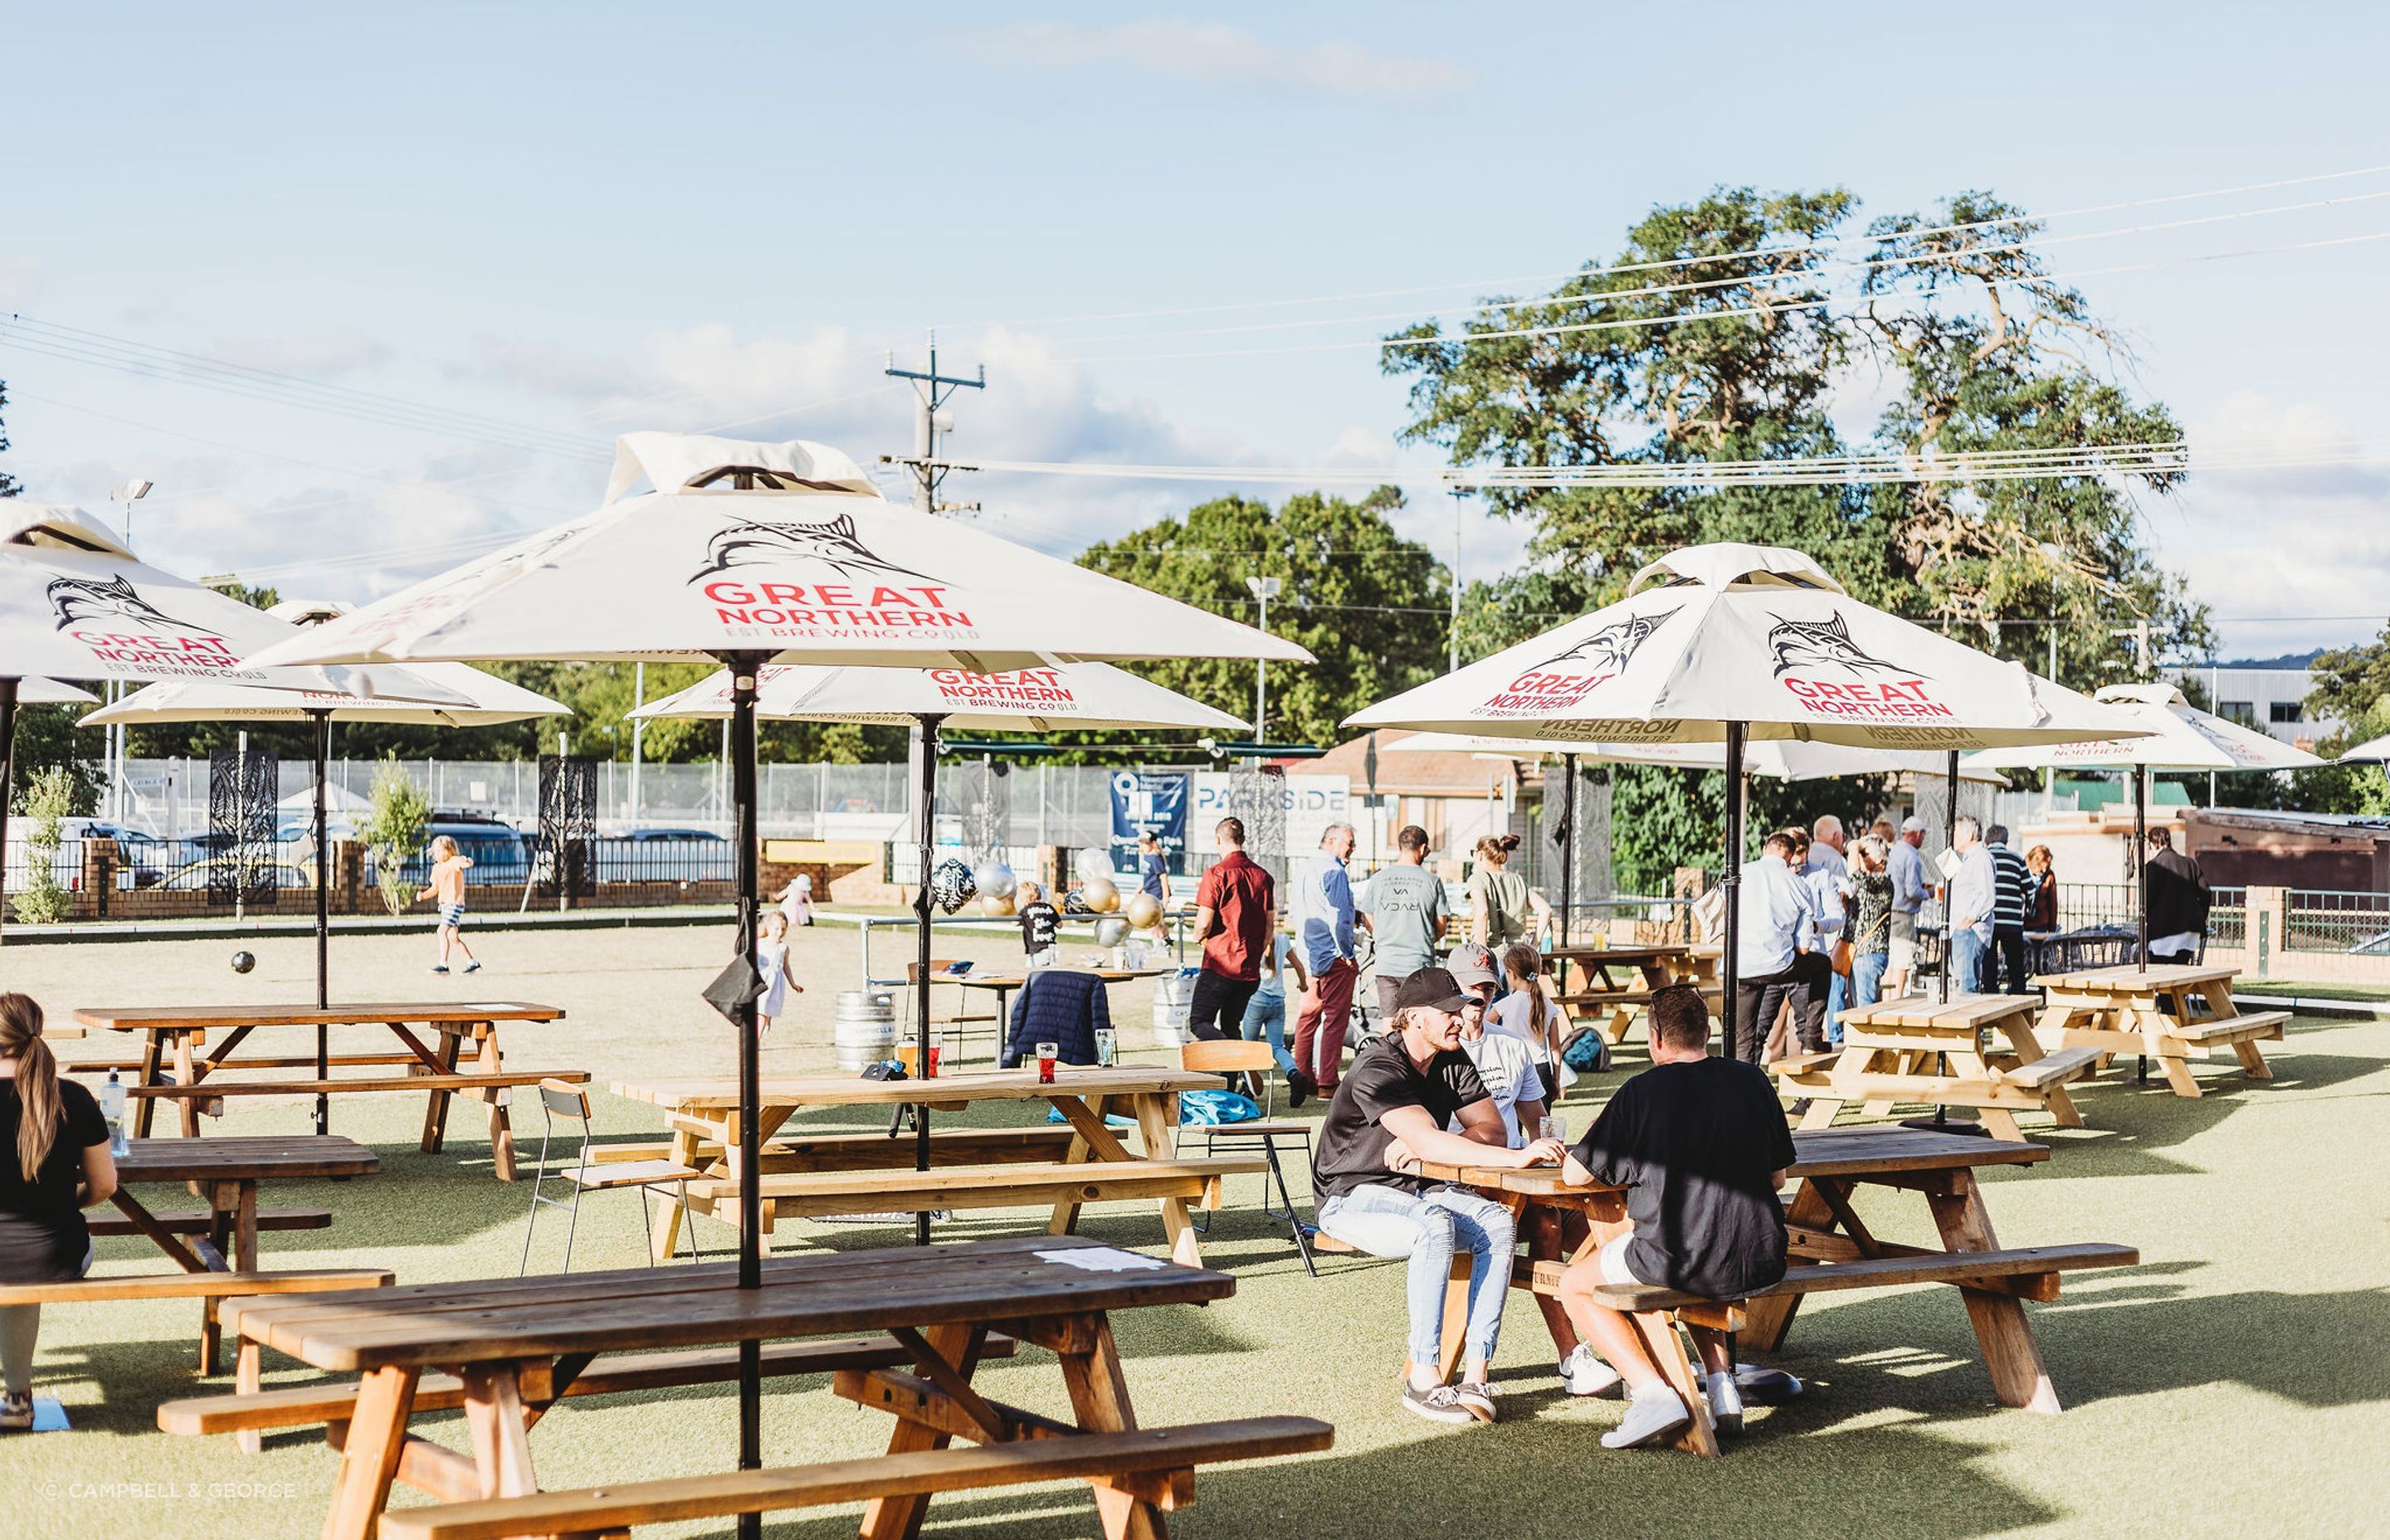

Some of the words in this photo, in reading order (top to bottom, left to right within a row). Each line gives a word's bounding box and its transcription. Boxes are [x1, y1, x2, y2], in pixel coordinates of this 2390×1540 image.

[705, 582, 949, 608] GREAT
[716, 608, 974, 627] NORTHERN
[726, 627, 761, 637] EST
[771, 627, 900, 639] BREWING
[71, 631, 233, 655] GREAT
[135, 665, 216, 677] BREWING
[930, 669, 1061, 687] GREAT
[1509, 672, 1616, 694] GREAT
[1784, 678, 1929, 701] GREAT
[939, 685, 1074, 702] NORTHERN
[1484, 694, 1587, 709] NORTHERN
[945, 698, 966, 707] EST
[970, 698, 1035, 710] BREWING
[1799, 699, 1954, 717] NORTHERN
